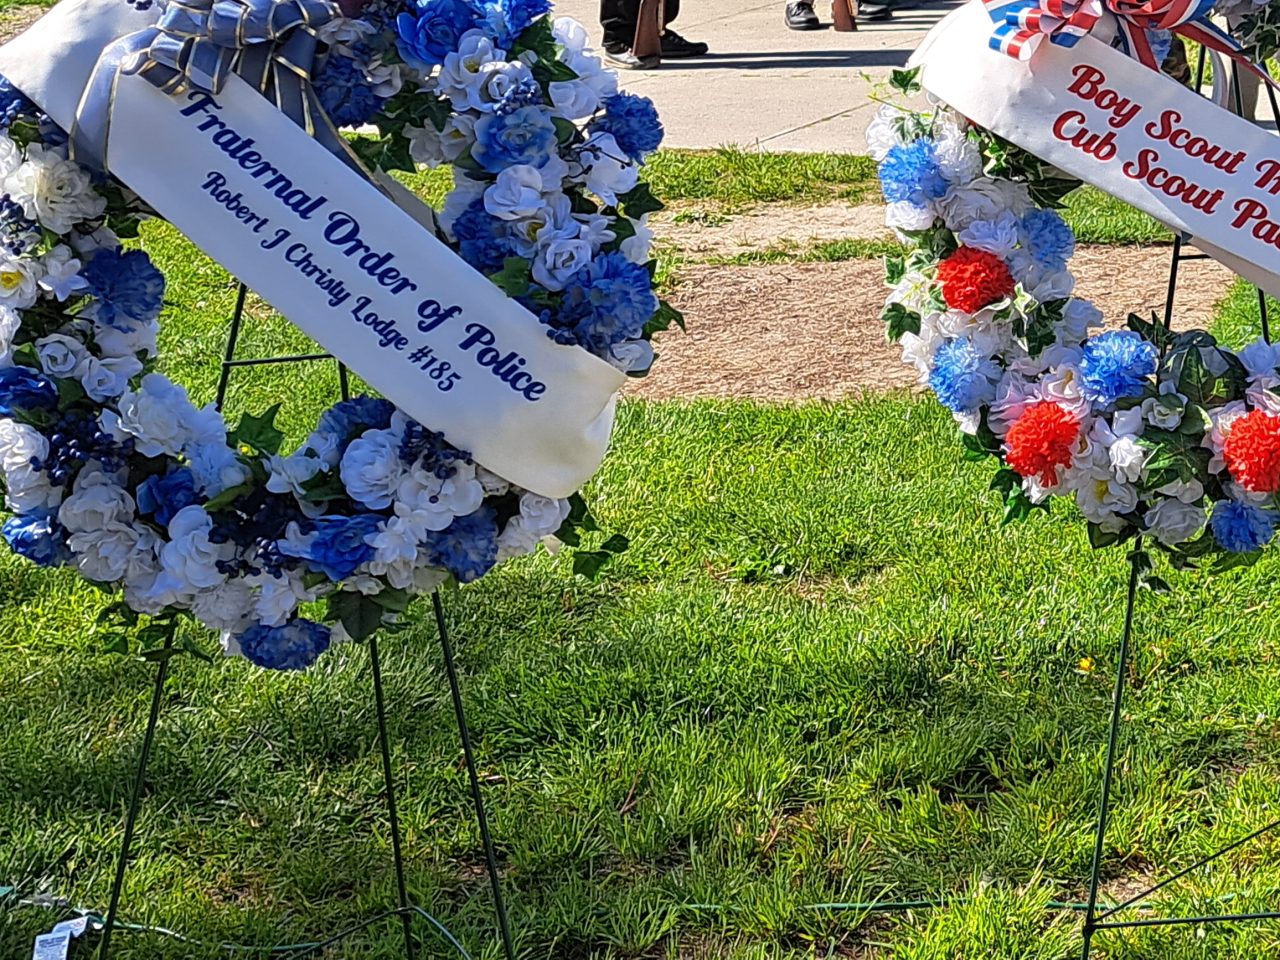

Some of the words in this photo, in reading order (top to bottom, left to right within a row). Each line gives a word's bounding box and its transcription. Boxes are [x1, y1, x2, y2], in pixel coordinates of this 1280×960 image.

[1052, 110, 1118, 161] Cub
[1122, 148, 1225, 215] Scout
[1067, 64, 1142, 128] Boy
[1145, 110, 1247, 174] Scout
[179, 90, 328, 220] Fraternal
[323, 211, 418, 296] Order
[417, 299, 463, 333] of
[458, 323, 546, 402] Police
[201, 171, 269, 233] Robert
[260, 228, 291, 250] J
[284, 242, 351, 308] Christy
[351, 296, 408, 351] Lodge
[407, 345, 463, 392] #185
